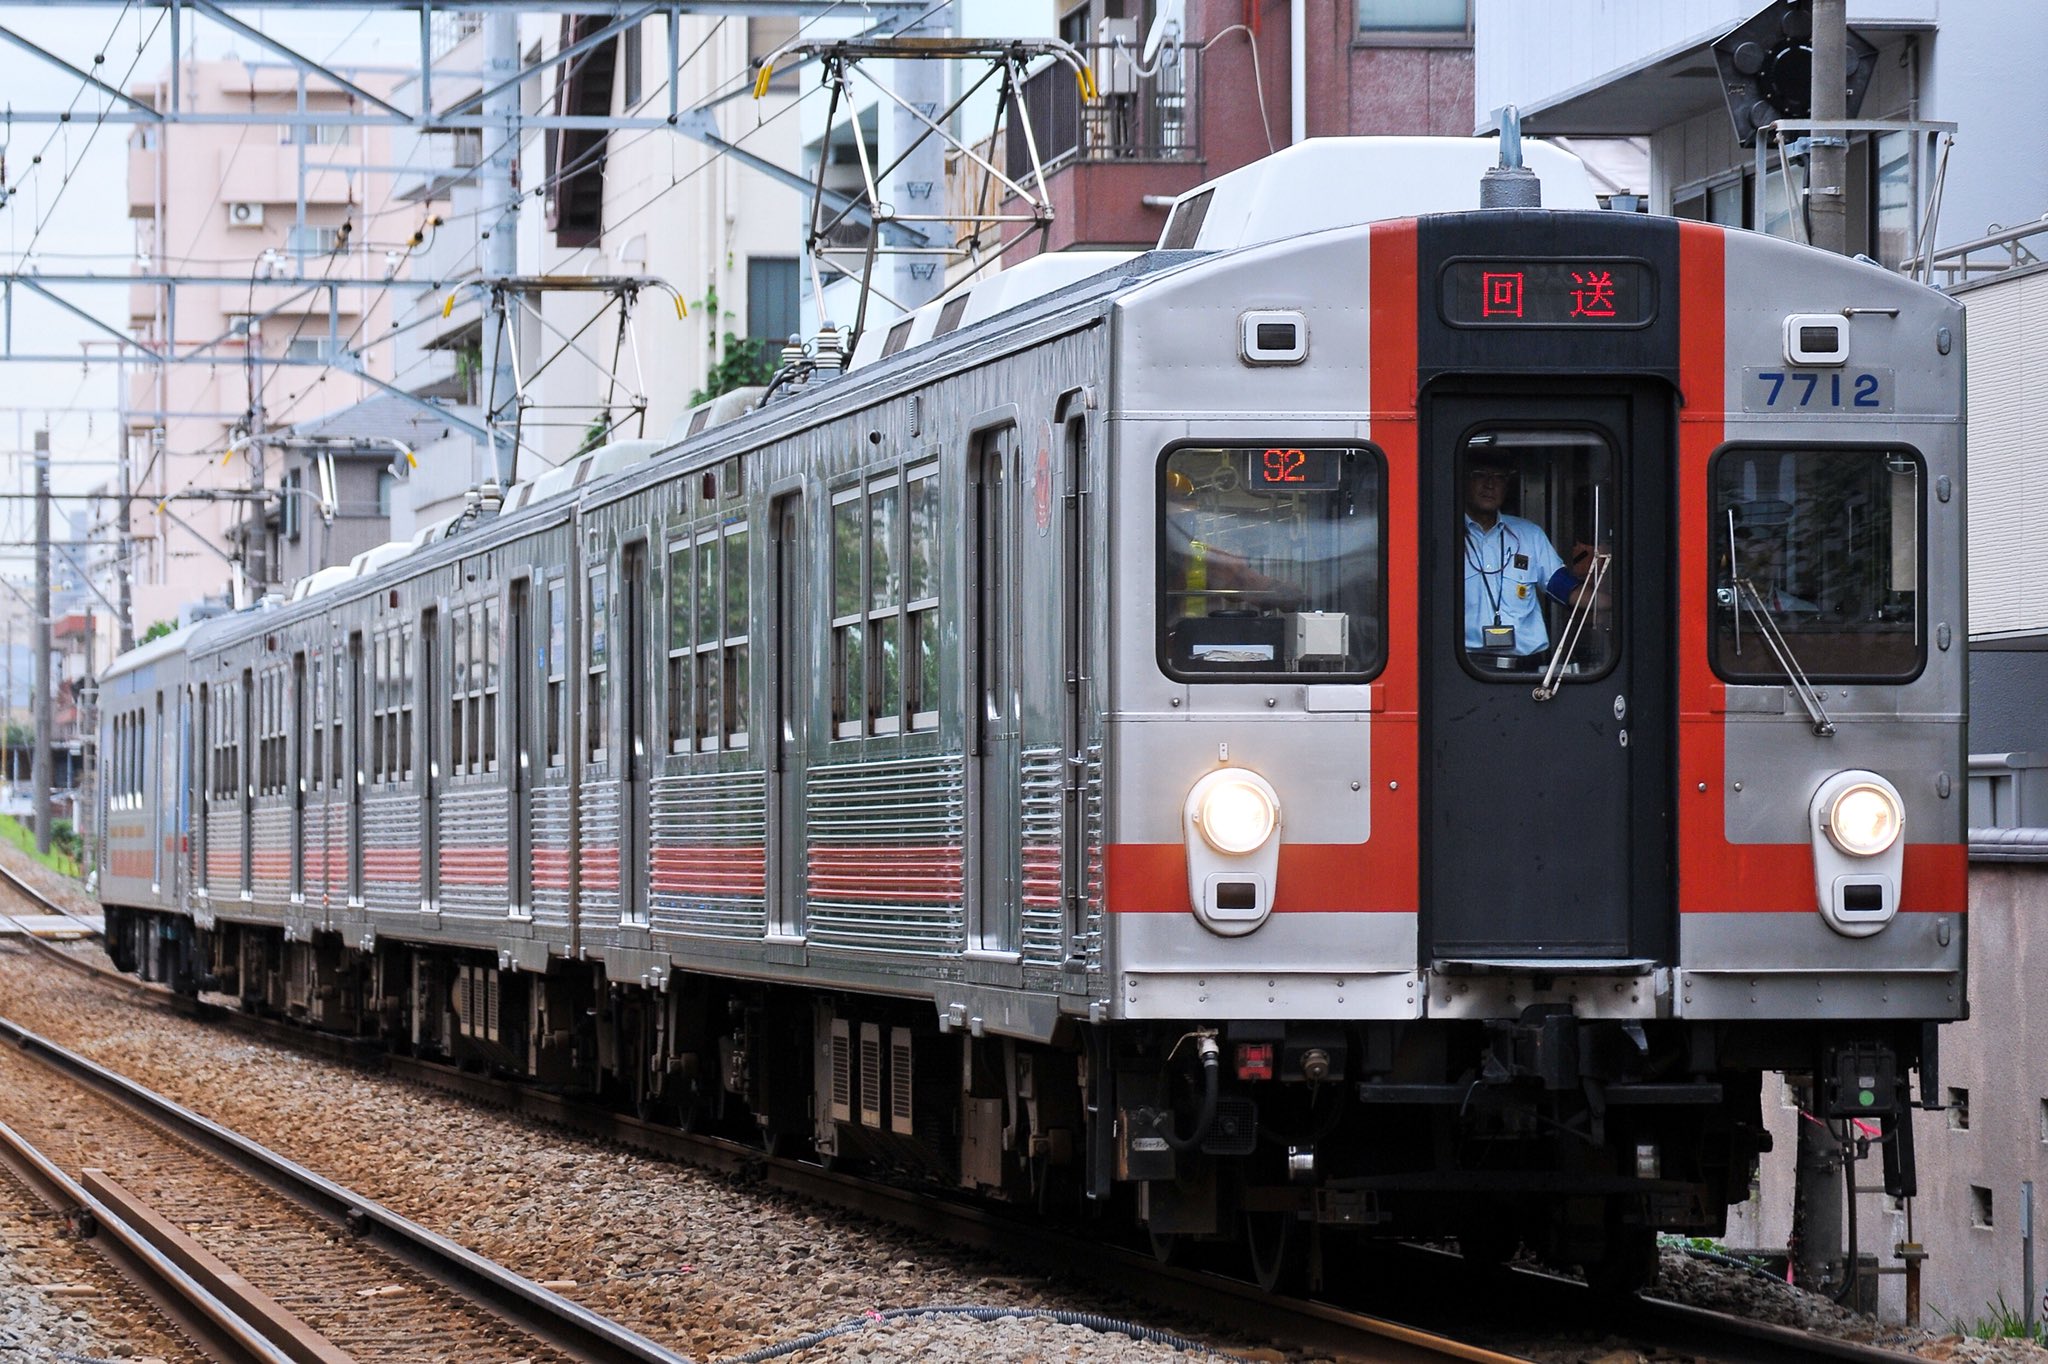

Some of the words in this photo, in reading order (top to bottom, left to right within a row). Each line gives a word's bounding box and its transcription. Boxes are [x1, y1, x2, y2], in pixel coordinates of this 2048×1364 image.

[1483, 272, 1616, 317] 回送
[1758, 373, 1880, 407] 7712
[1263, 449, 1305, 482] 92
